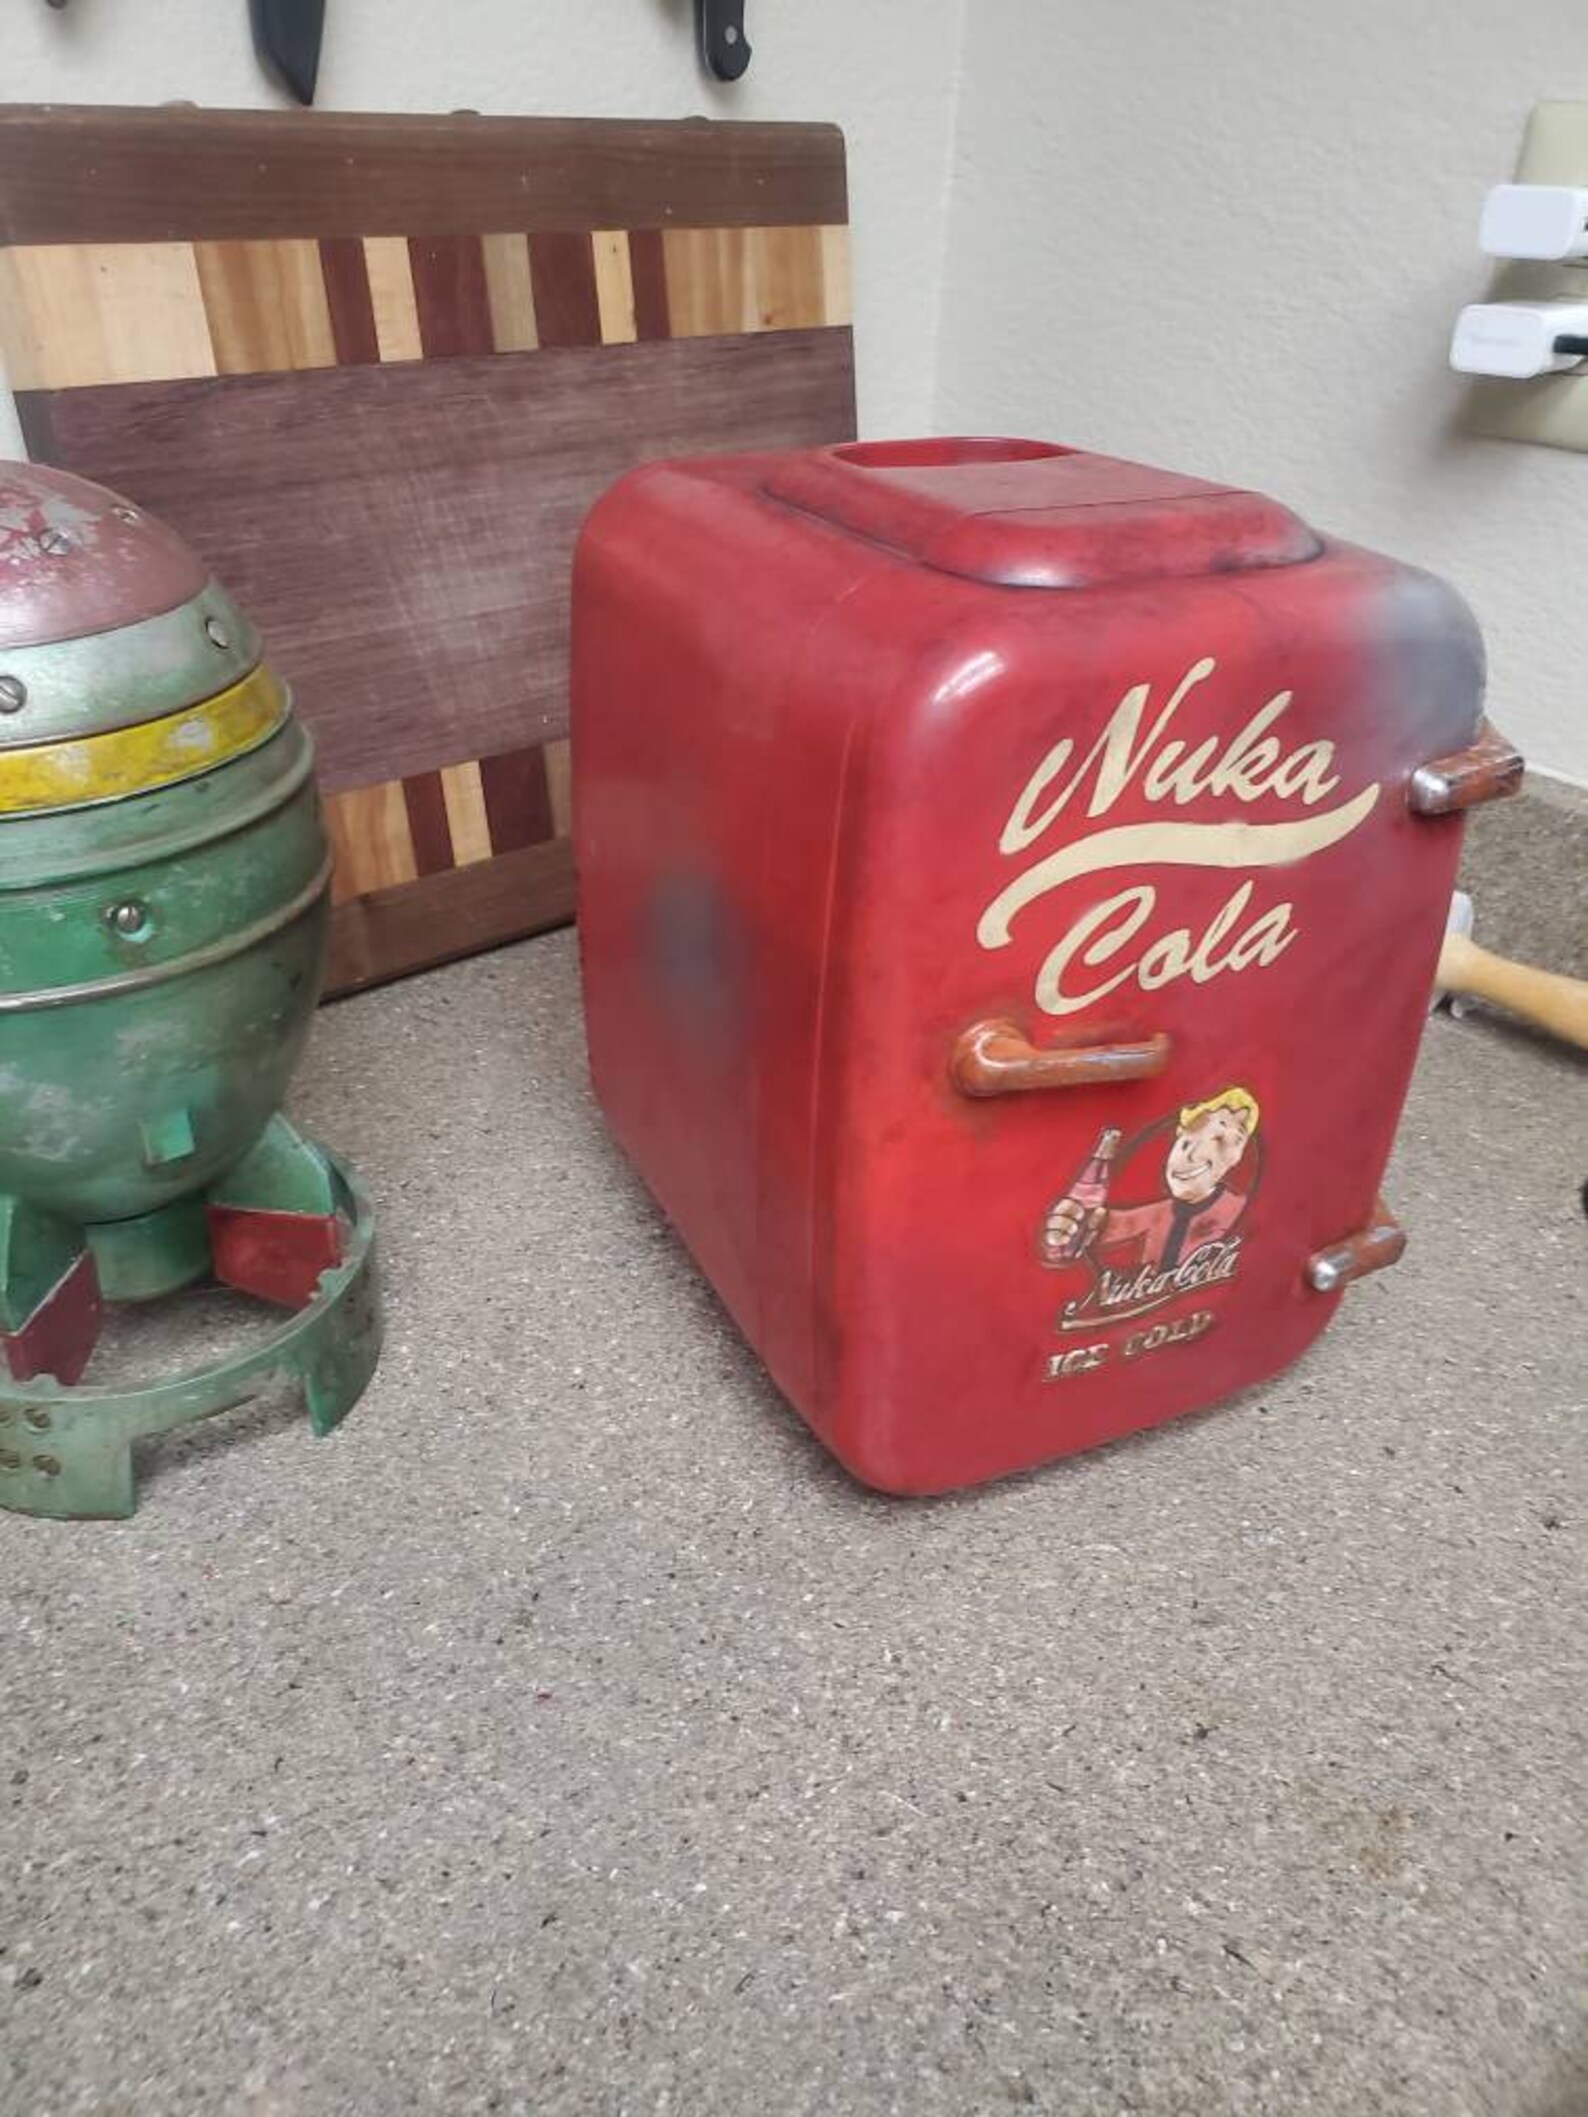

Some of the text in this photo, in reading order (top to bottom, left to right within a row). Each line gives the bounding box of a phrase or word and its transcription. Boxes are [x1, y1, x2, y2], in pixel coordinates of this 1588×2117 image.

[1000, 656, 1340, 855] Nuka
[1034, 879, 1299, 1015] Cola
[1044, 1343, 1109, 1379] ICE
